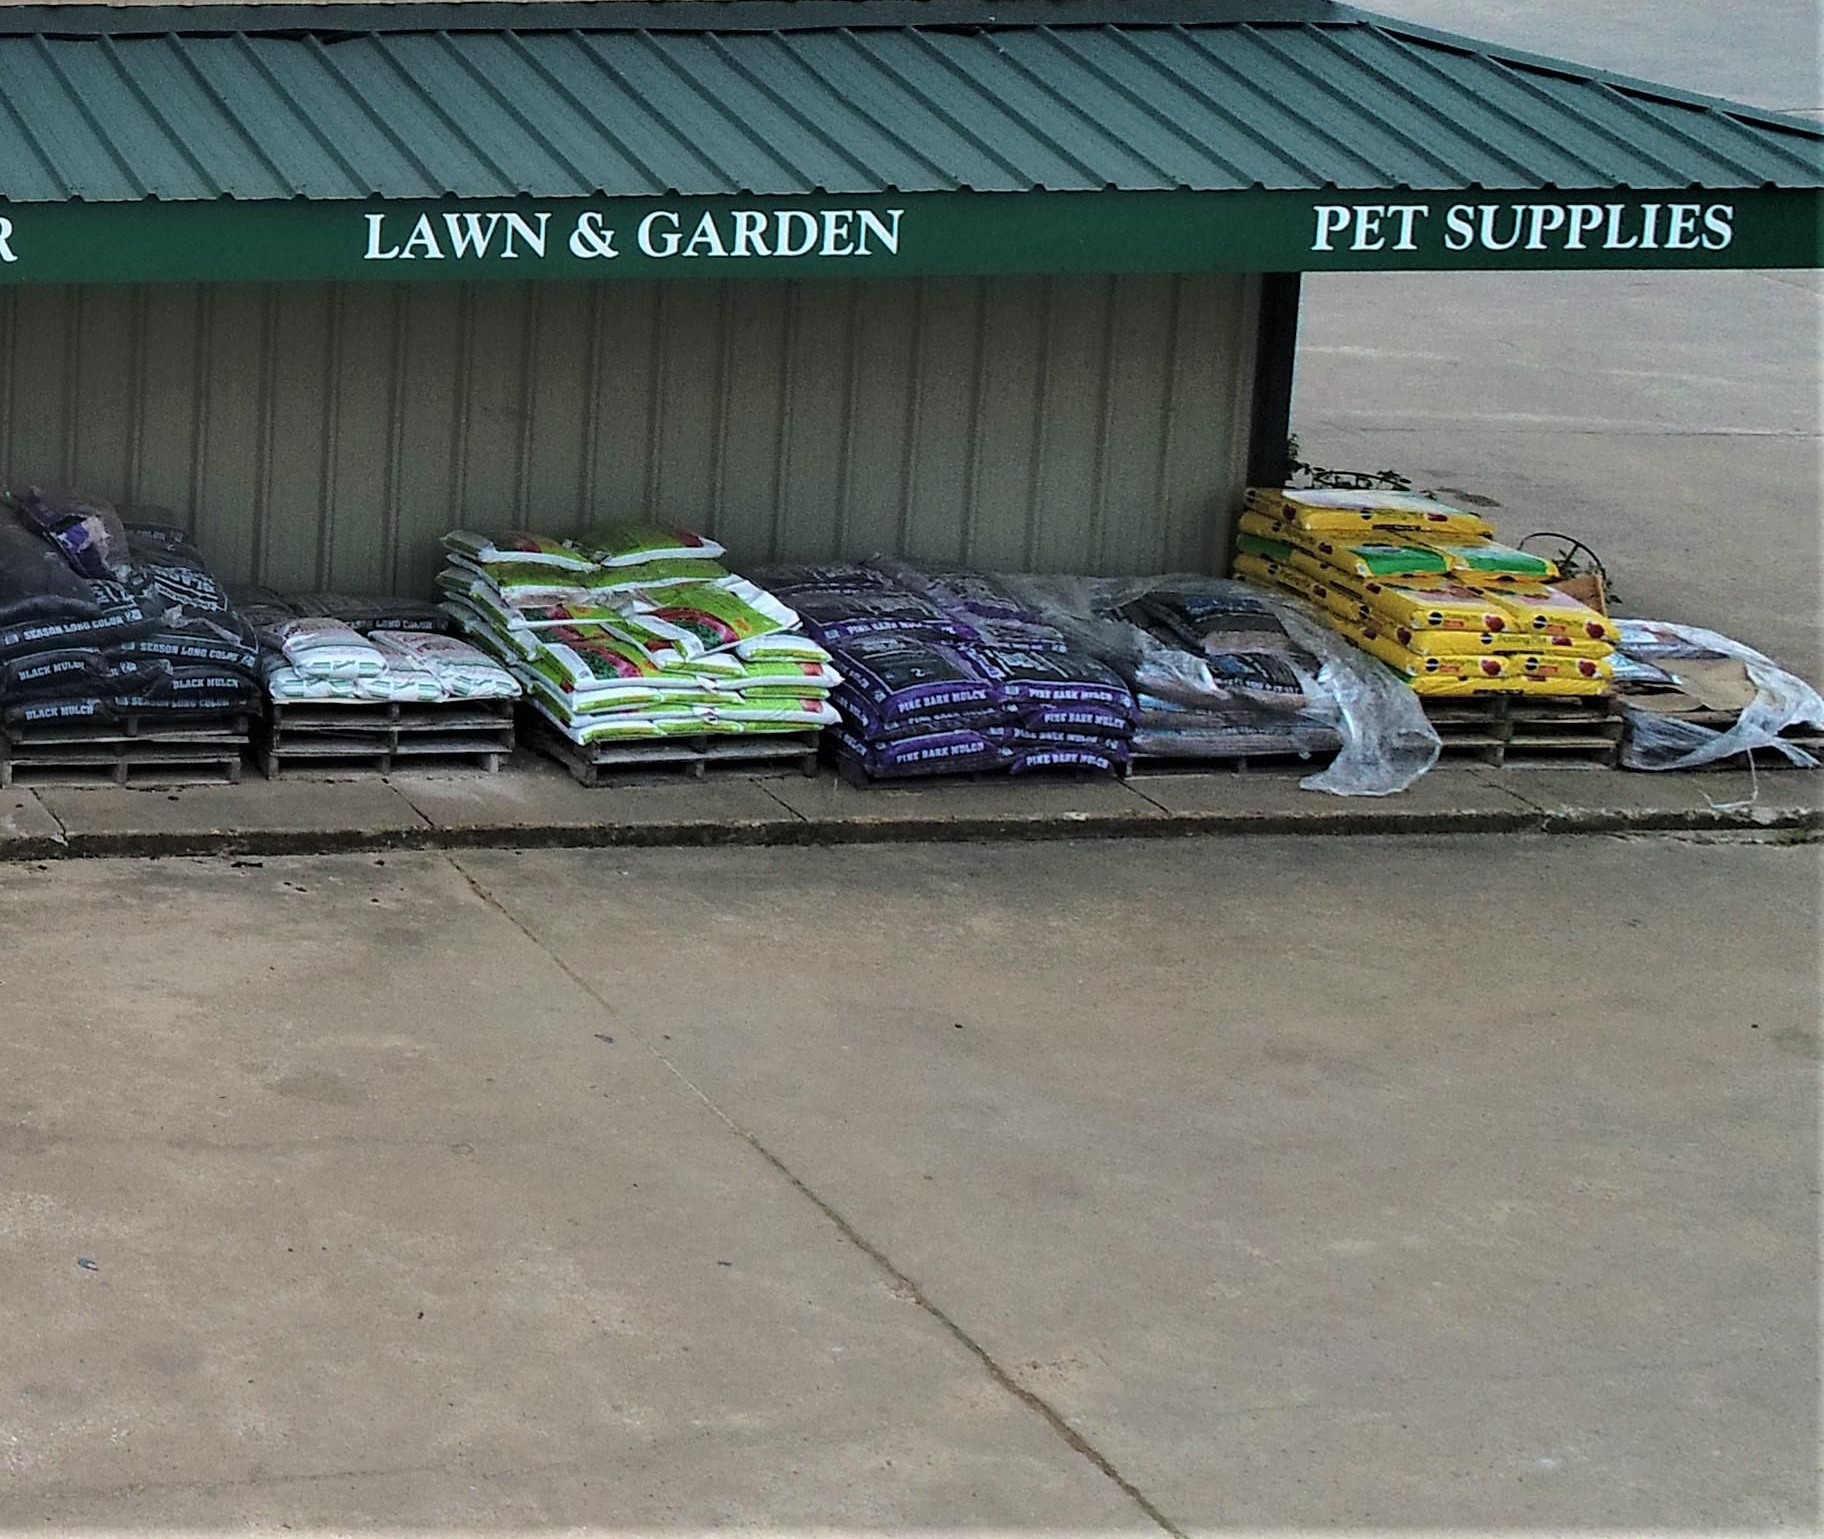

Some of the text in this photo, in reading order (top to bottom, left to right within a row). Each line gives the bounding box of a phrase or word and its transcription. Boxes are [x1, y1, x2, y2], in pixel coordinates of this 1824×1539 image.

[363, 209, 905, 259] LAWN & GARDEN
[1310, 203, 1734, 251] PET SUPPLIES
